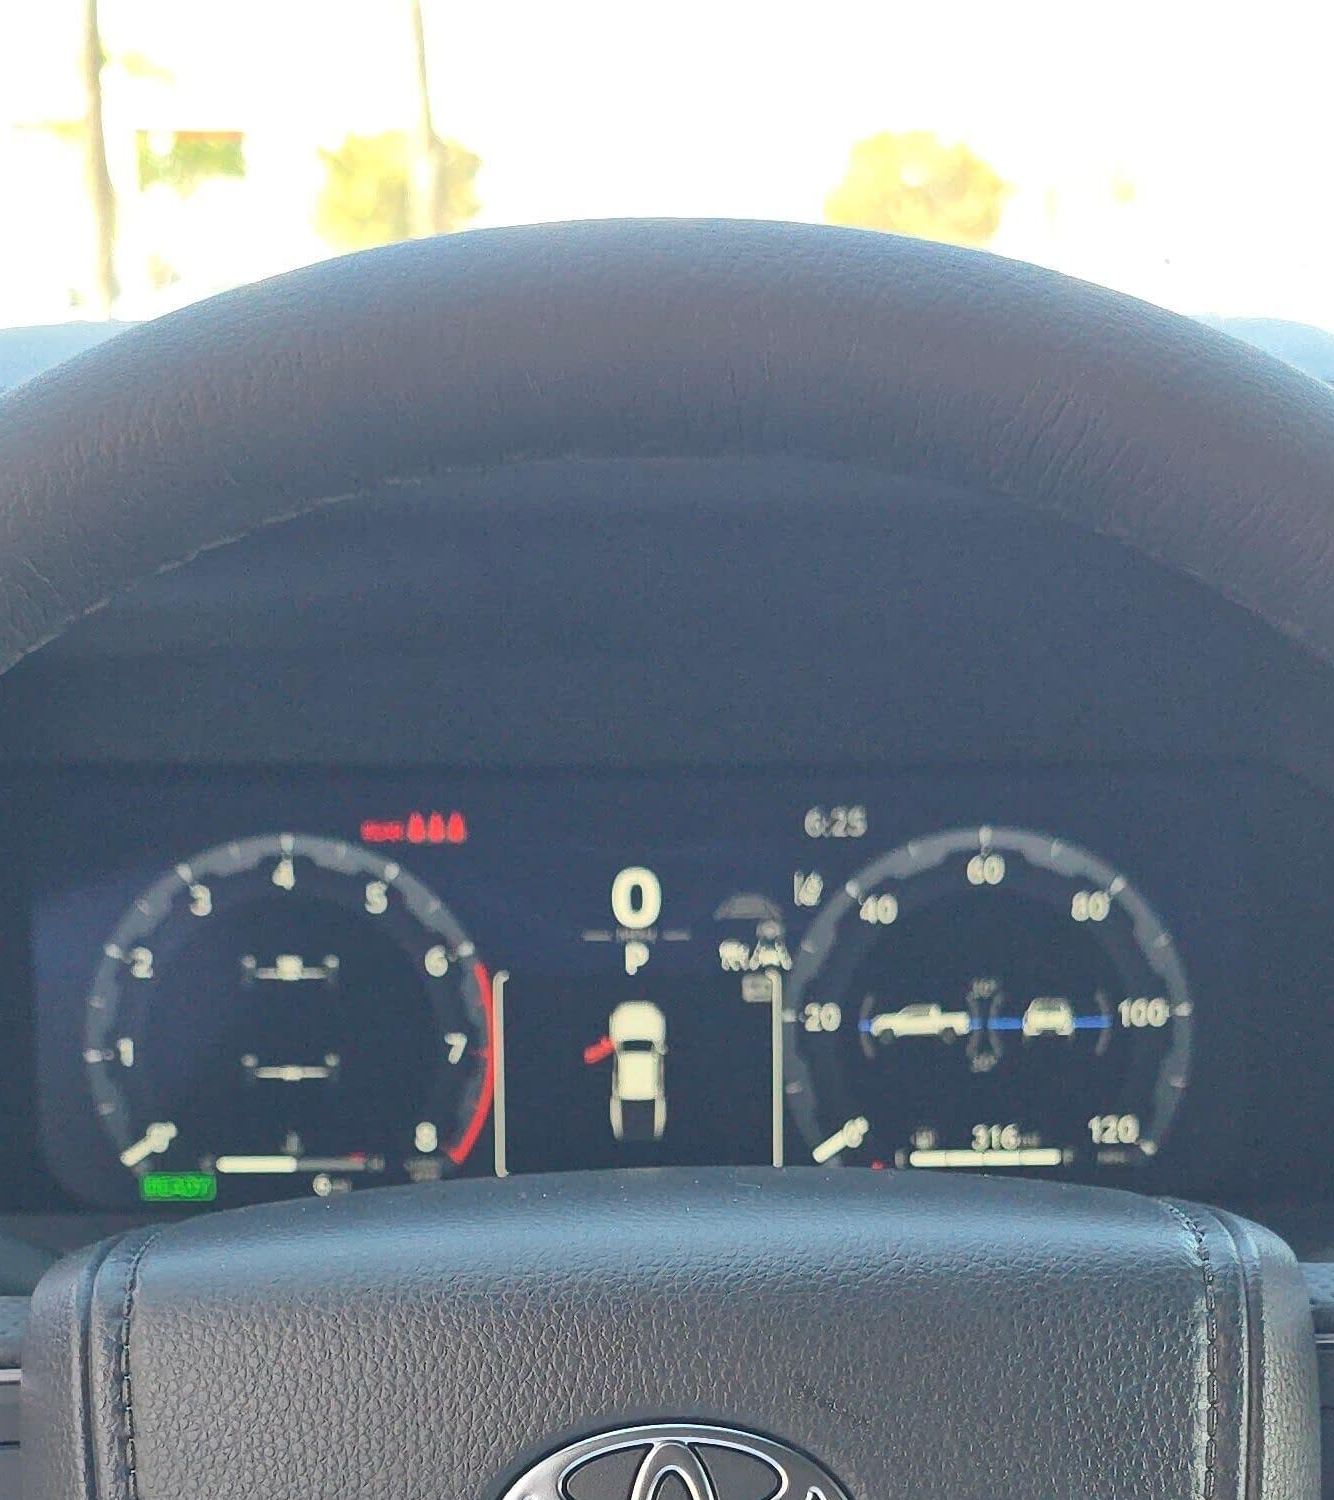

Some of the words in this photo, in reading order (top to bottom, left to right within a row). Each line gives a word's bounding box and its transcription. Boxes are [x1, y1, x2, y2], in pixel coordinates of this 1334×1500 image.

[804, 805, 867, 838] 6:25
[967, 855, 1005, 886] 60
[189, 884, 212, 916] 3
[365, 881, 388, 914] 5
[611, 866, 662, 929] 0
[859, 893, 898, 925] 40
[132, 947, 154, 978] 2
[625, 941, 650, 976] P
[804, 1002, 841, 1032] 20
[1119, 998, 1170, 1028] 100
[444, 1032, 467, 1065] 7
[971, 1124, 1021, 1151] 316
[1087, 1114, 1140, 1144] 120
